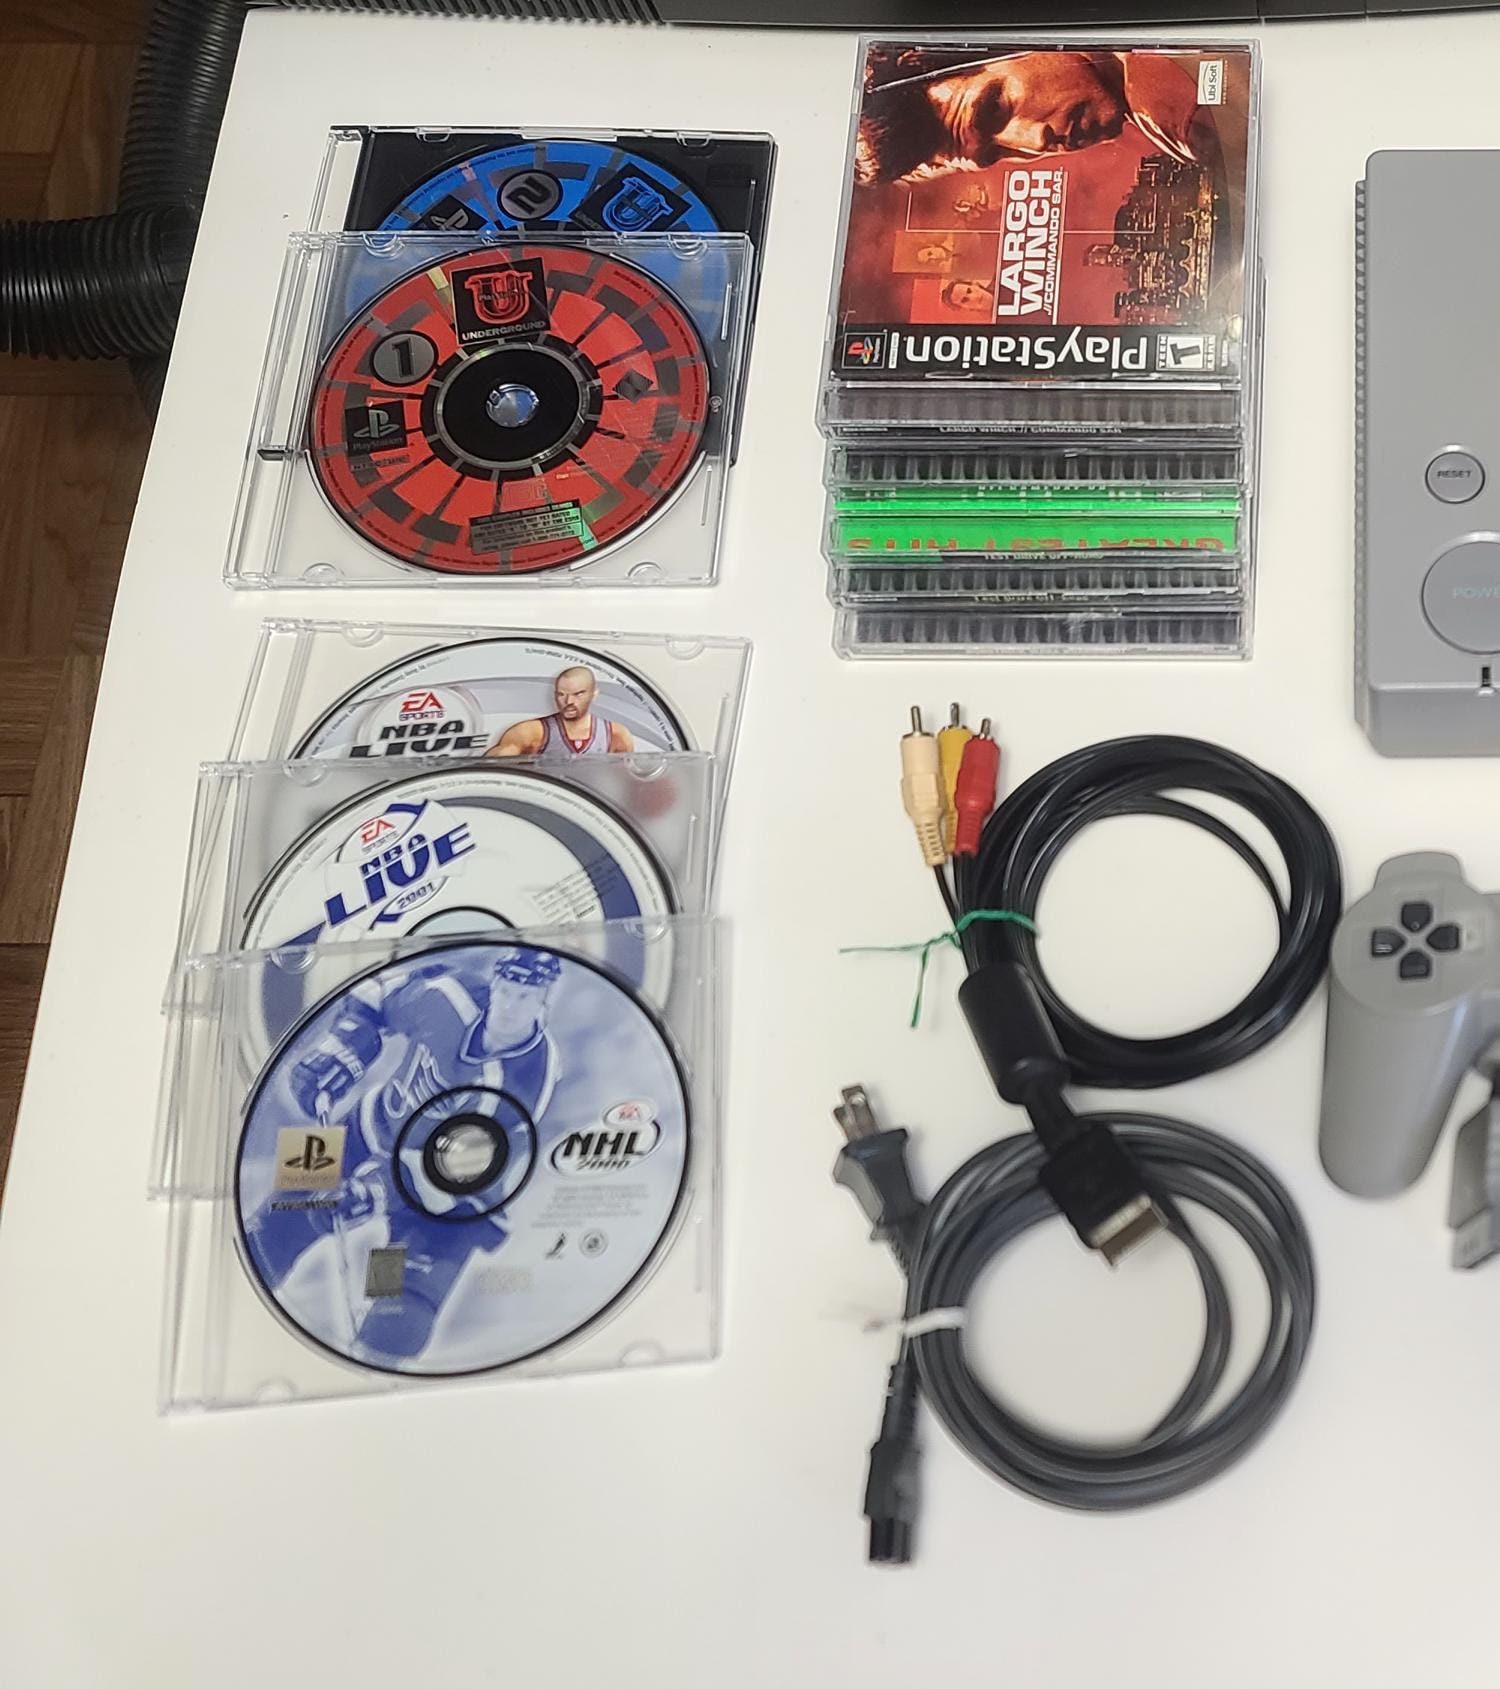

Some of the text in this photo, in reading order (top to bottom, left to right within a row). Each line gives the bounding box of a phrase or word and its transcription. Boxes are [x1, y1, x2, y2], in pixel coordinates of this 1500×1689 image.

[1207, 64, 1218, 101] Ubi Soft
[506, 174, 553, 217] 2
[998, 170, 1030, 316] LARGO
[1020, 170, 1053, 316] WINCH
[462, 319, 546, 341] UNDERGROUND
[391, 337, 415, 377] 1
[906, 327, 1148, 370] PlayStation
[1158, 335, 1167, 369] TEEN
[1437, 470, 1472, 479] RESET
[399, 710, 447, 722] SPORTS
[402, 692, 444, 712] EA
[378, 719, 465, 741] NBA
[349, 732, 490, 760] LIVE
[361, 818, 396, 844] EA
[360, 832, 428, 876] NBA
[324, 822, 477, 927] LIVE
[396, 880, 437, 910] 2001
[562, 1131, 647, 1158] NHL
[576, 1157, 631, 1171] 2000
